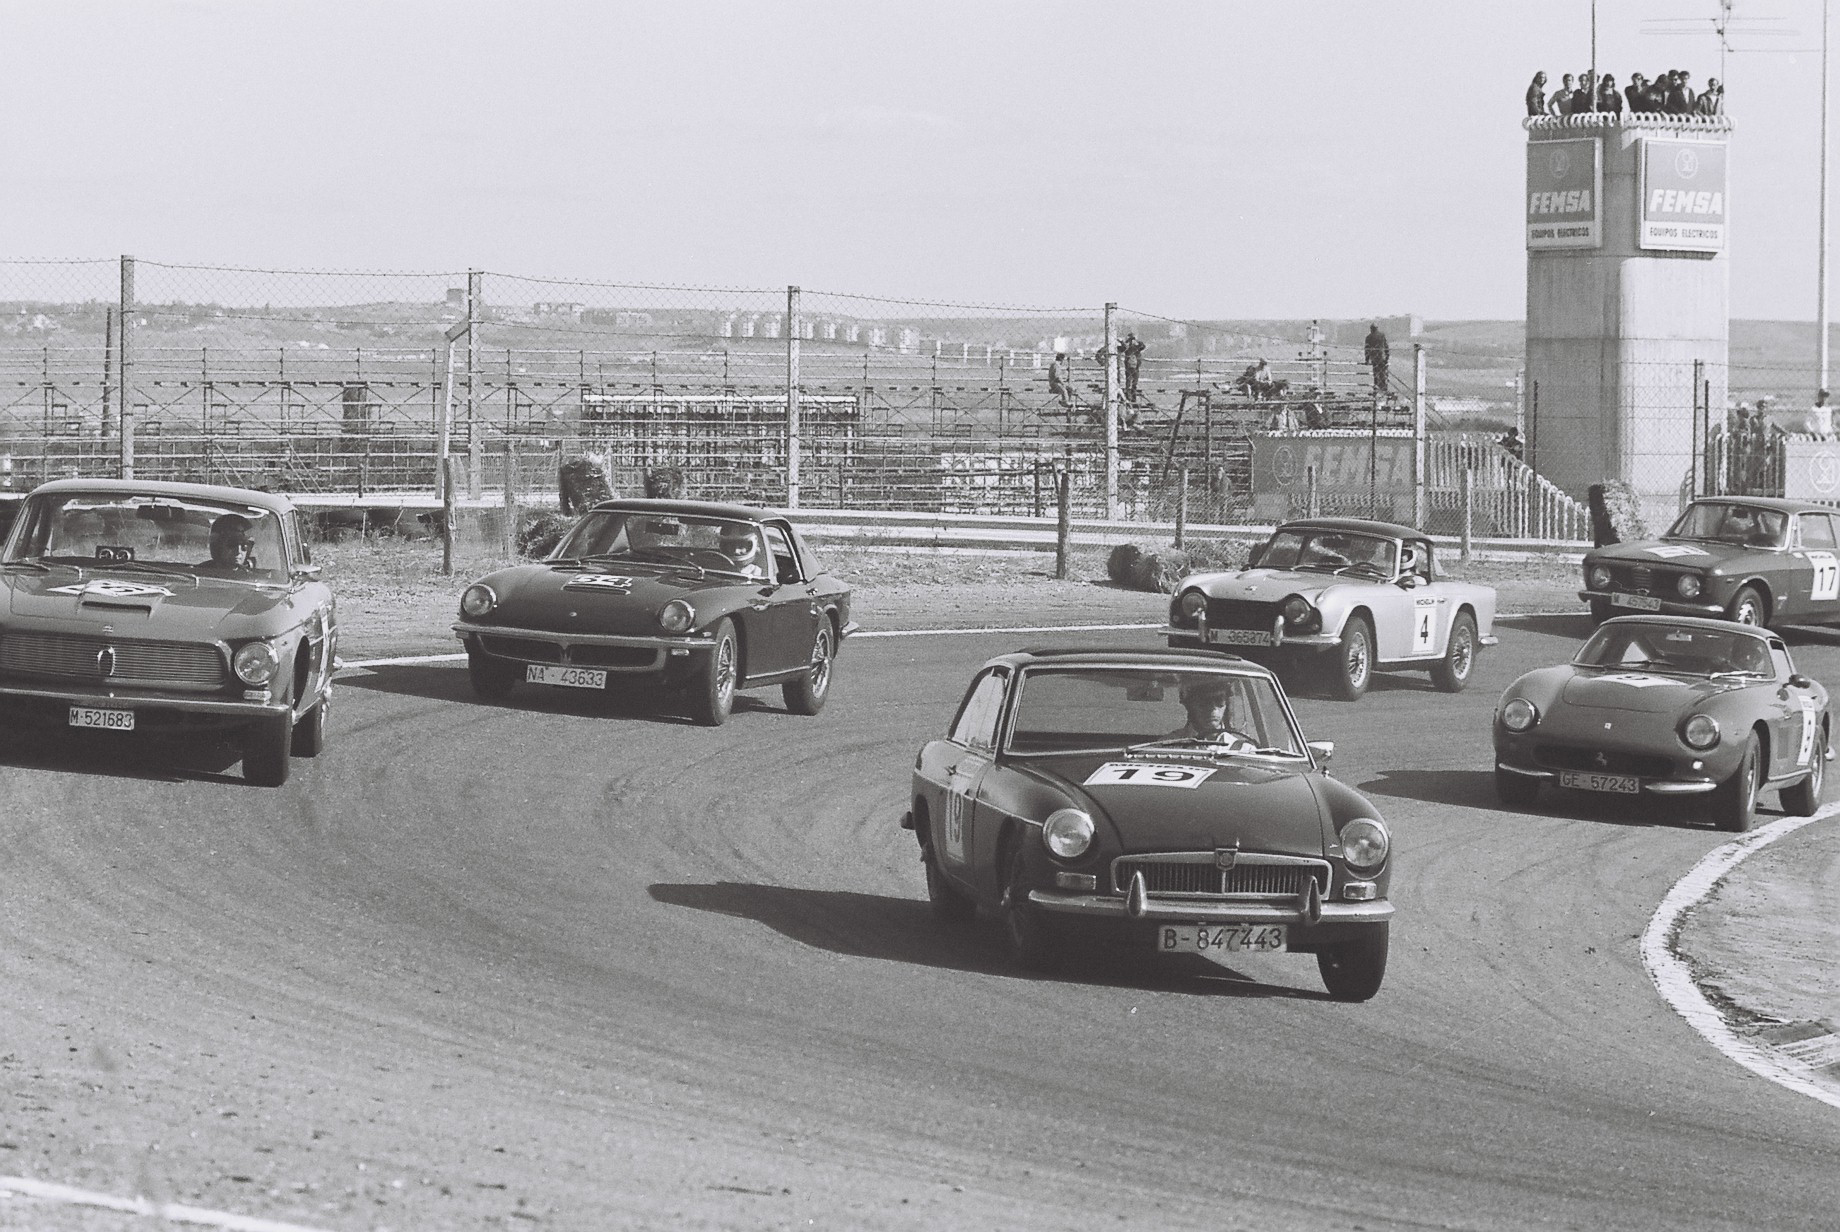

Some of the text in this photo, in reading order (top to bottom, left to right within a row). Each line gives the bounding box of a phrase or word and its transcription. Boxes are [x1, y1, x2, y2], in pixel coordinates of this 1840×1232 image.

[1529, 190, 1590, 214] FEMSA
[1648, 188, 1722, 215] FEMSA
[1302, 445, 1412, 486] FEMSA
[1819, 566, 1837, 592] 17
[1420, 614, 1429, 644] 4
[1112, 768, 1195, 782] 19
